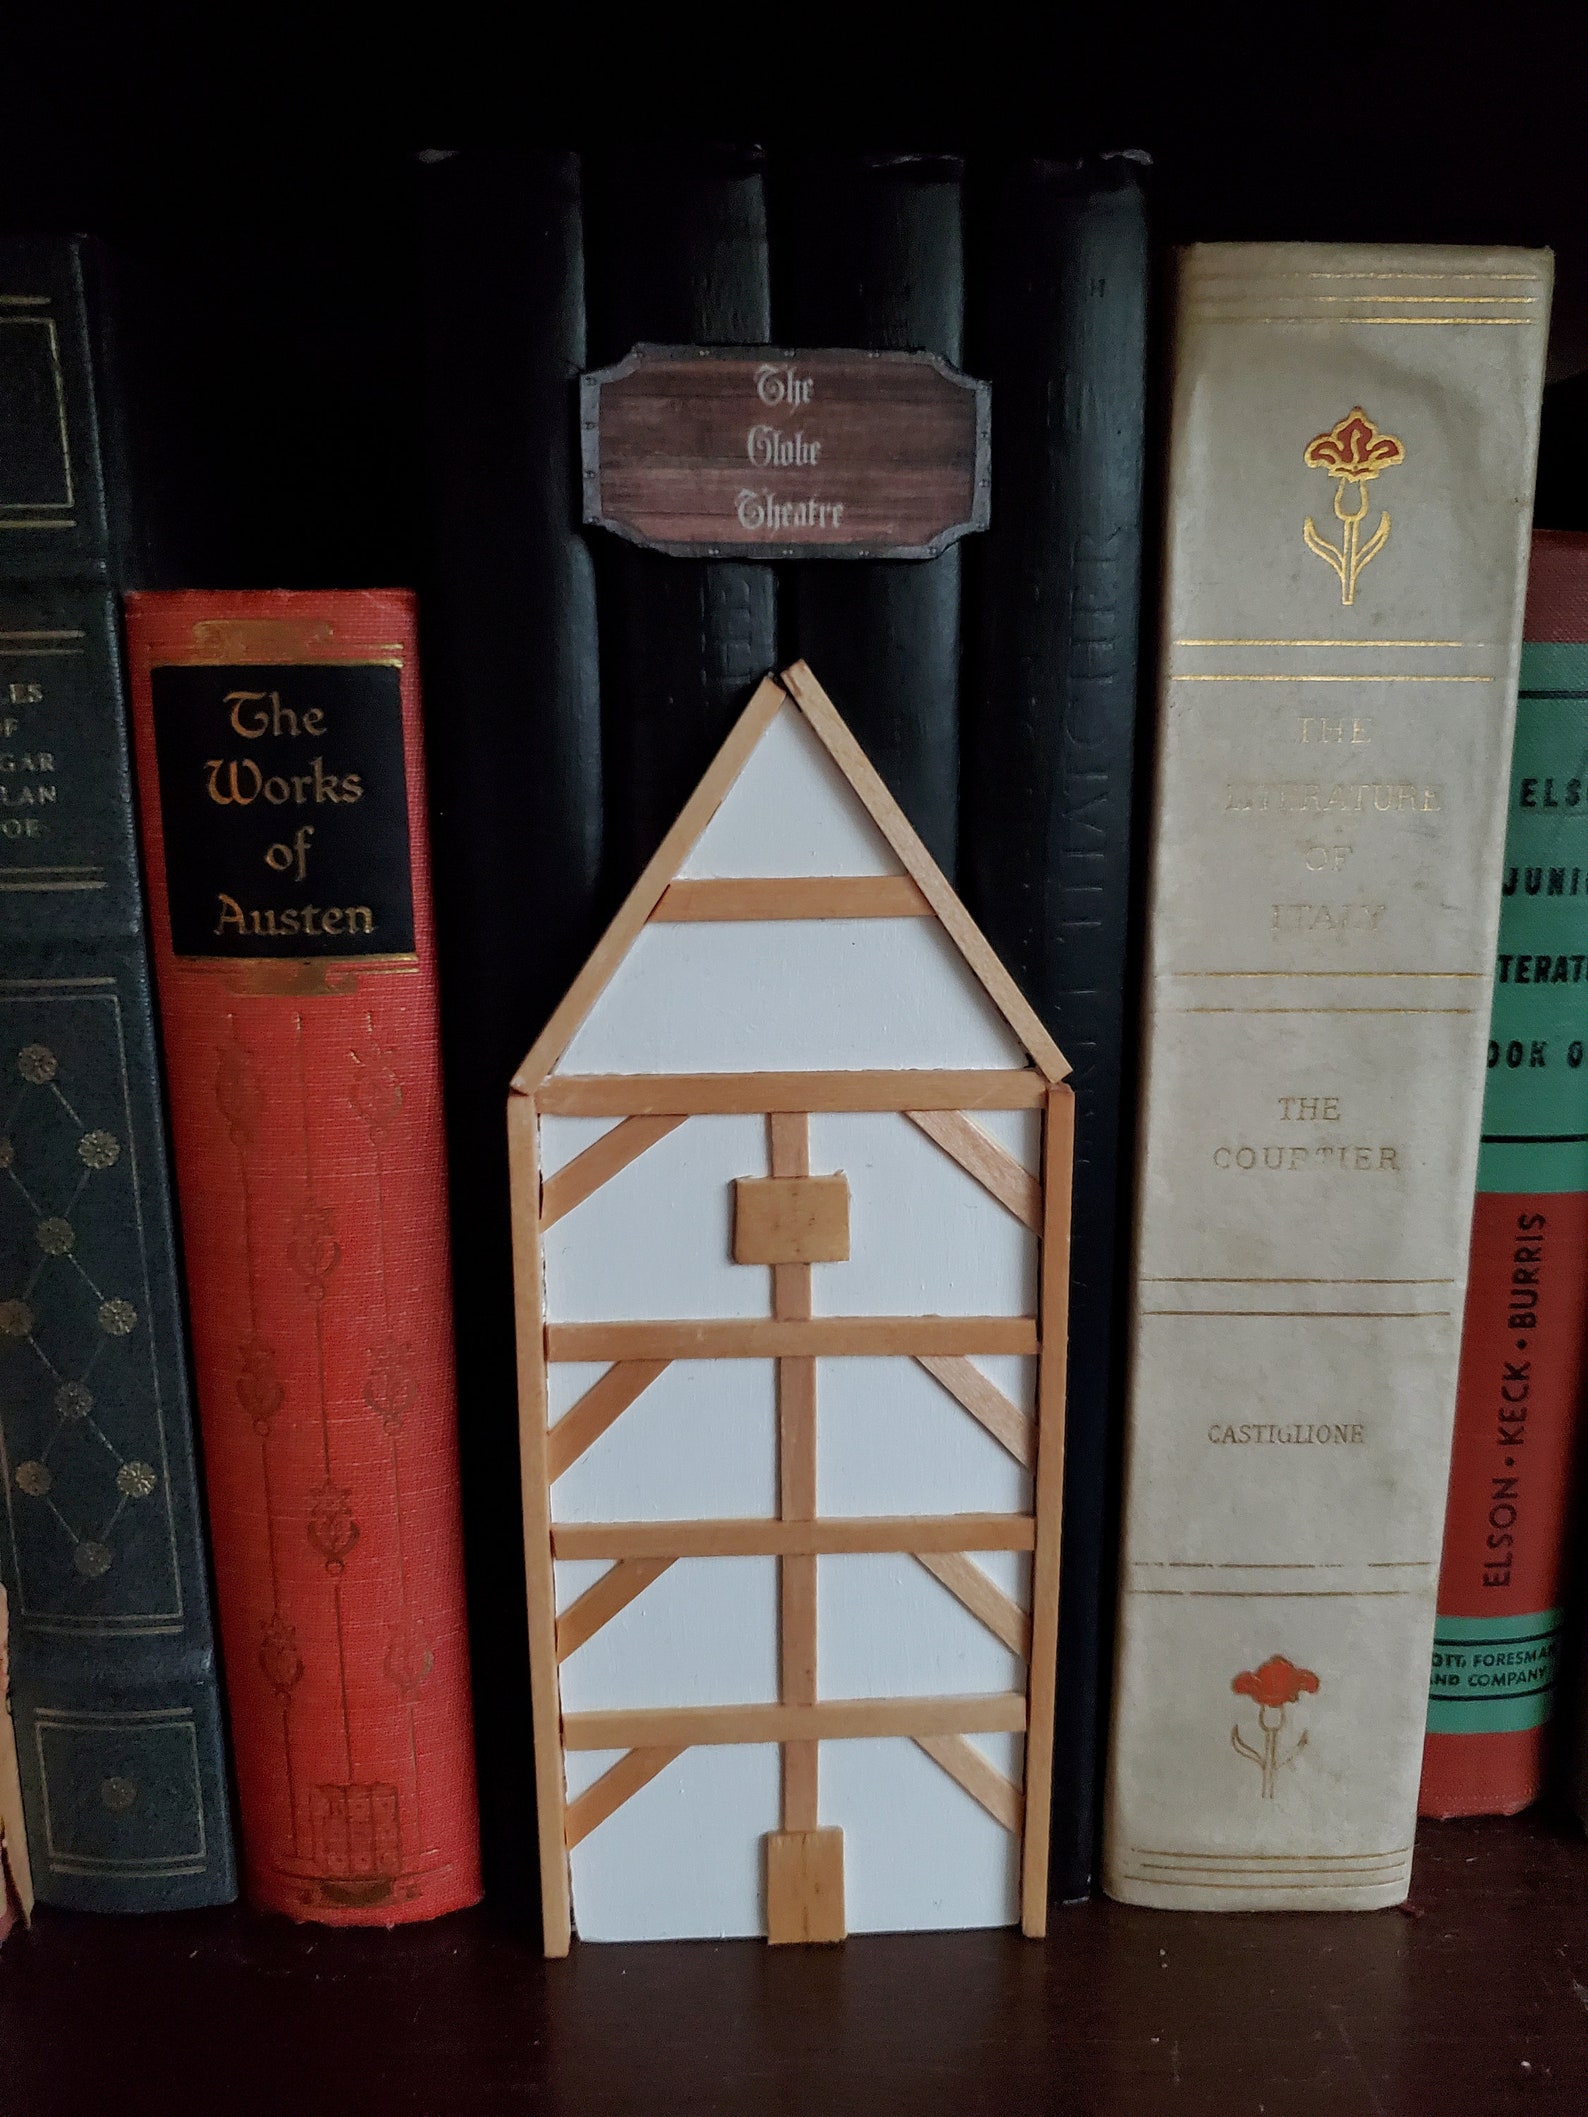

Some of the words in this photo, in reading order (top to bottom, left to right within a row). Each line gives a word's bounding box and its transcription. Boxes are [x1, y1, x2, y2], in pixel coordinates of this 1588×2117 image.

[752, 363, 815, 414] The
[747, 424, 822, 468] Globe
[735, 487, 845, 535] Theatre
[222, 690, 328, 740] The
[1297, 717, 1374, 744] THE
[204, 756, 365, 806] Works
[1519, 778, 1588, 807] ELS
[1225, 782, 1447, 813] LITERATURE
[264, 825, 316, 882] of
[1304, 845, 1354, 873] OF
[1501, 867, 1588, 897] JUNI
[213, 893, 377, 936] Austen
[1270, 904, 1388, 931] ITALY
[1497, 954, 1588, 984] TERAT
[1278, 1097, 1342, 1122] THE
[1212, 1147, 1402, 1172] COURTIER
[1508, 1212, 1547, 1330] BURRIS
[1499, 1360, 1531, 1446] KECK
[1207, 1424, 1365, 1445] CASTIGLIONE
[1482, 1476, 1519, 1589] ELSON
[1468, 1664, 1548, 1688] COMPANY
